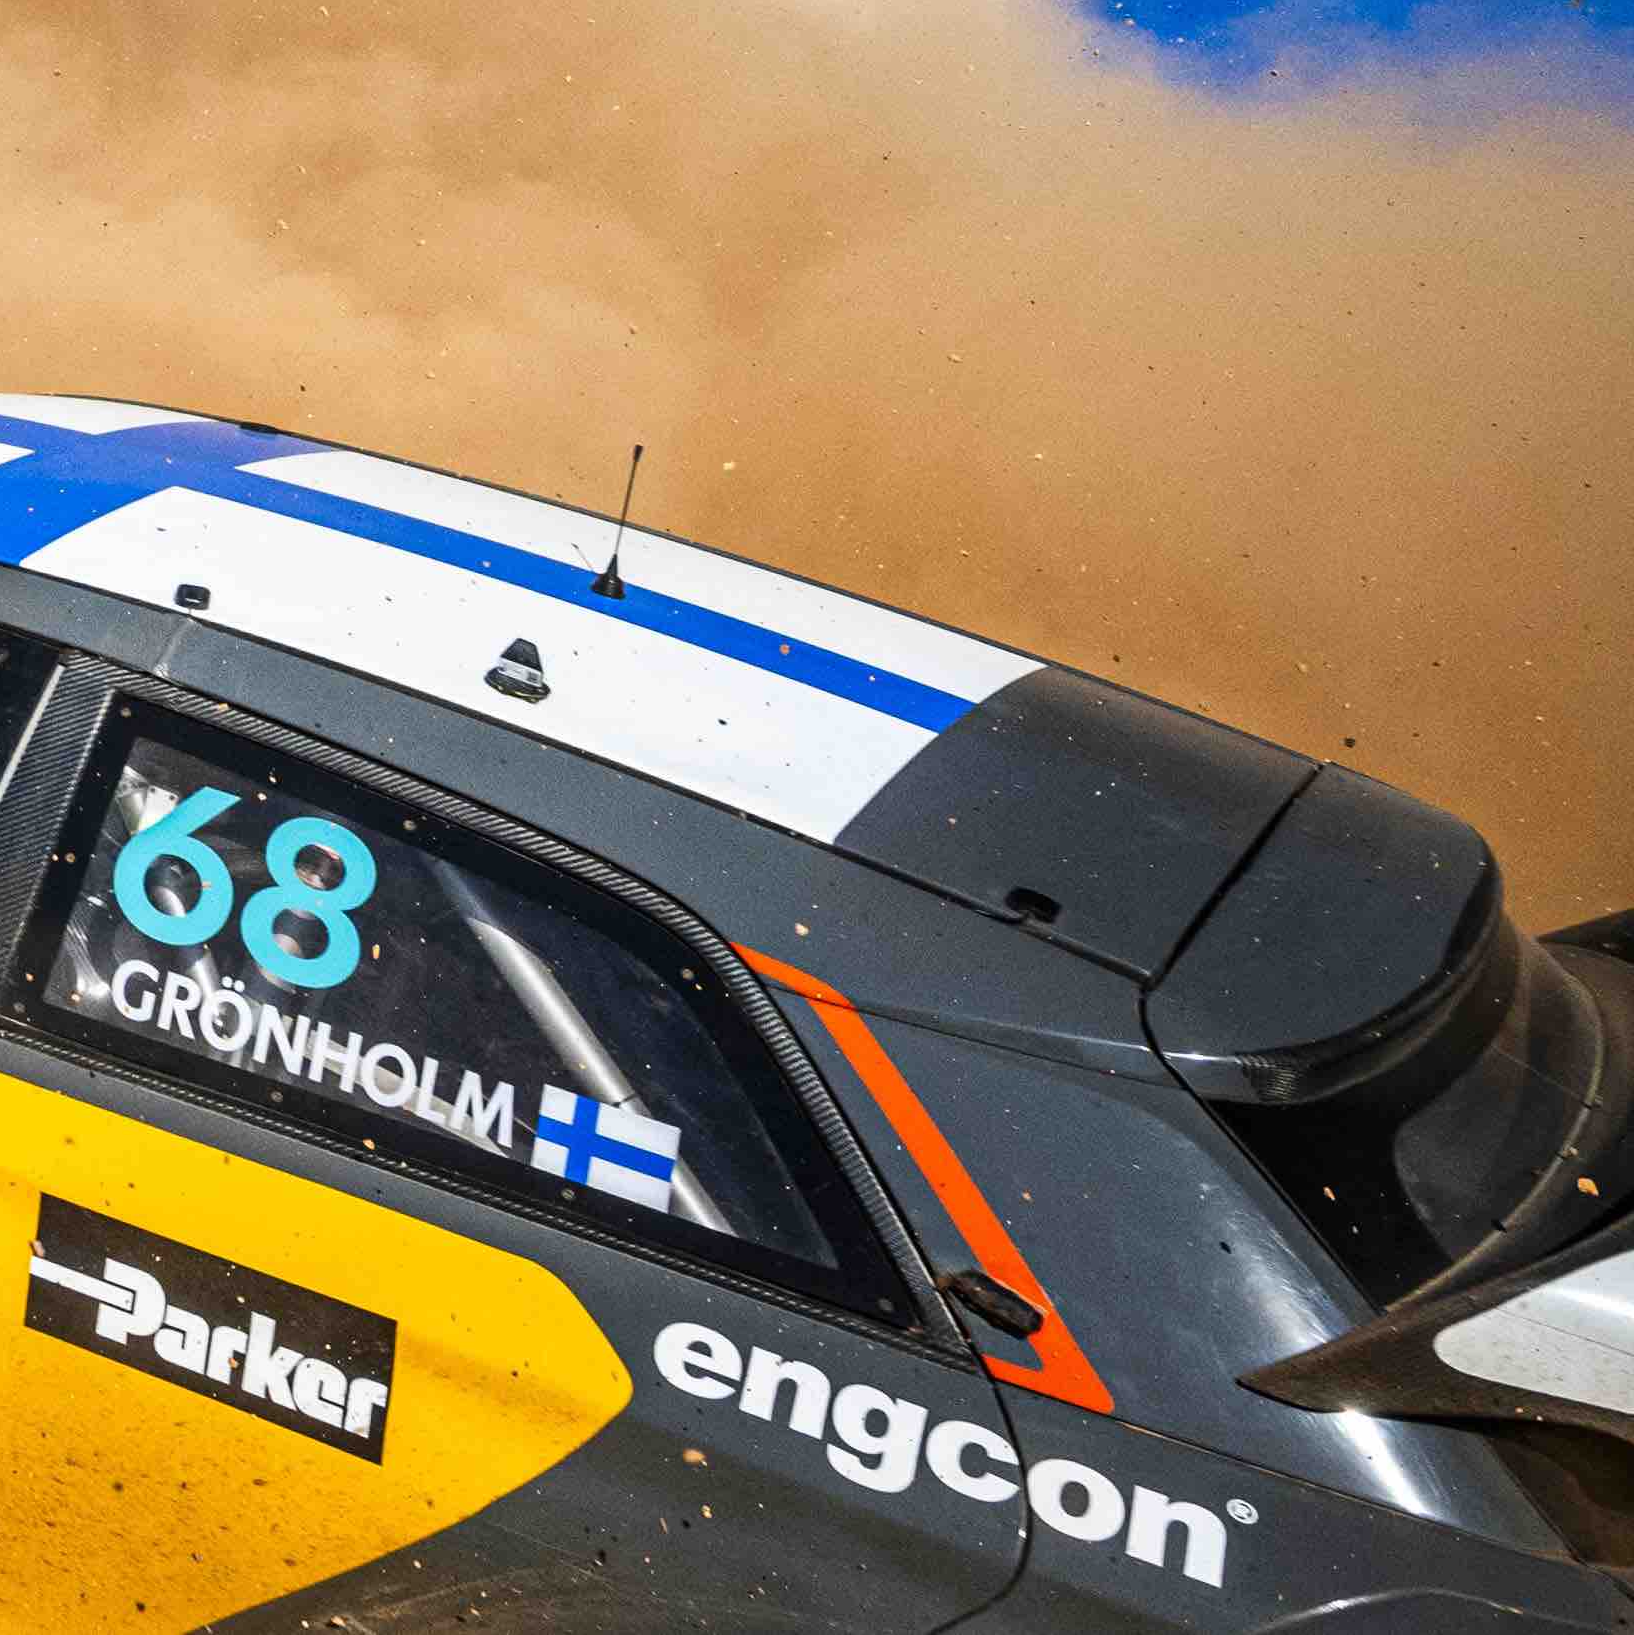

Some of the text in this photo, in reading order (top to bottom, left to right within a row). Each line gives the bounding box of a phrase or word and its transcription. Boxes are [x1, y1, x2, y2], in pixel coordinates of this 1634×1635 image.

[113, 786, 377, 990] 68
[110, 958, 516, 1150] GRÖNHOLM
[29, 1256, 388, 1439] Parker
